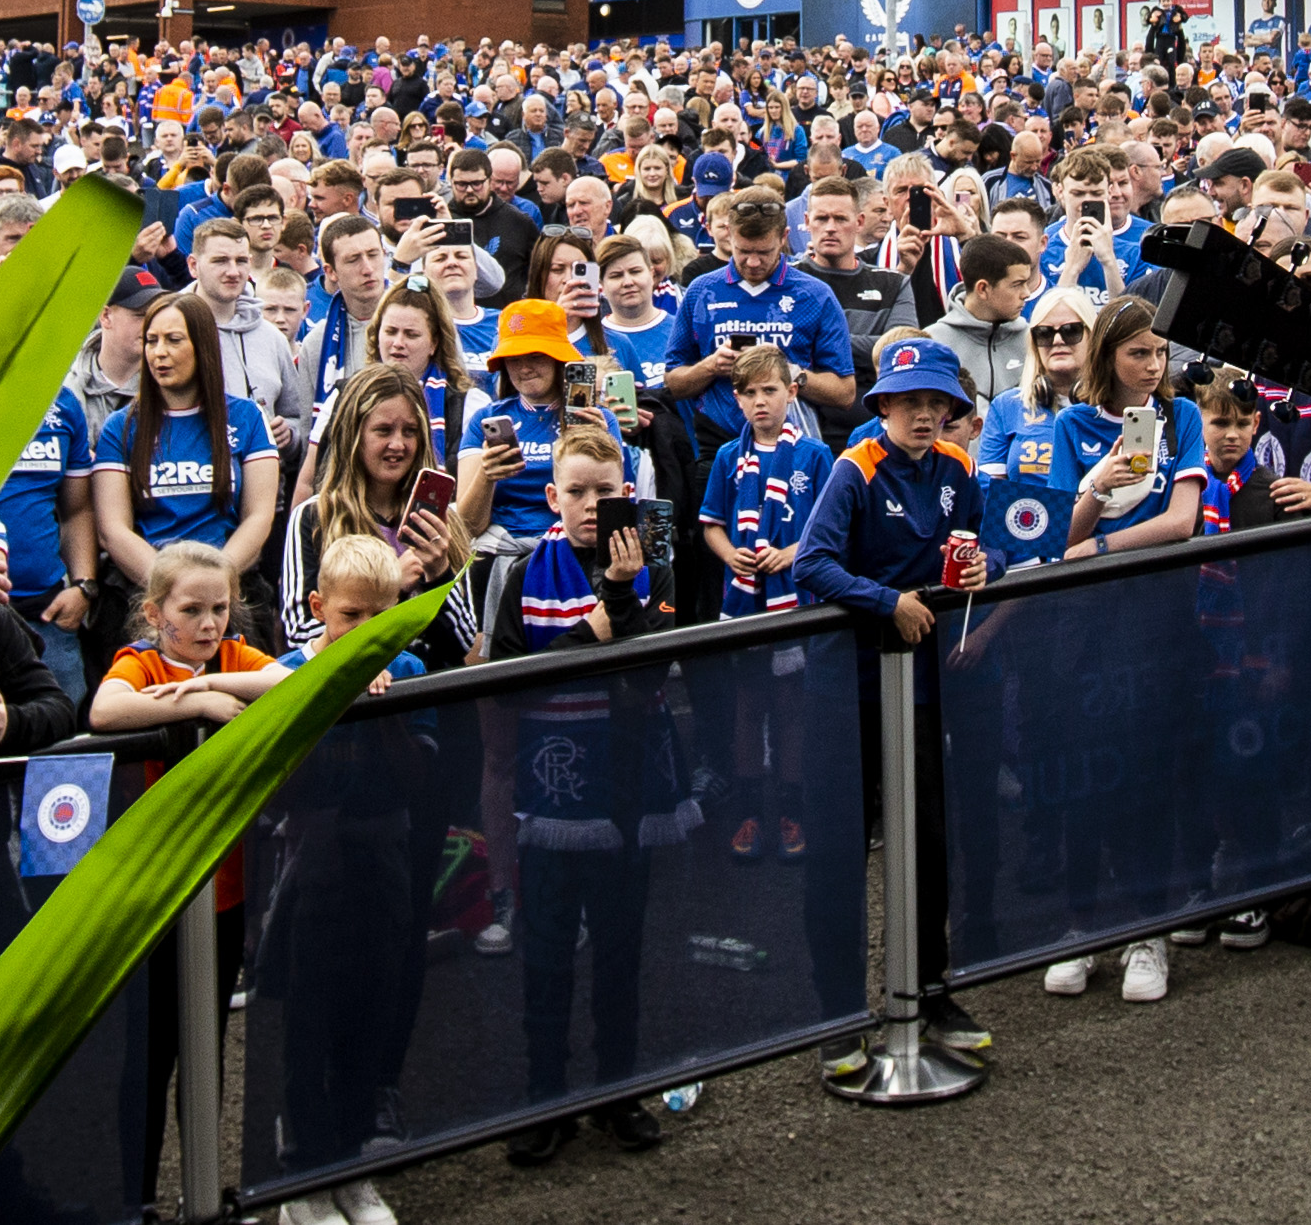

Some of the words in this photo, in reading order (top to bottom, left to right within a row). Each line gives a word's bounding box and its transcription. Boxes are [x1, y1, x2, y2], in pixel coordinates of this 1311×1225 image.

[714, 319, 794, 334] ntl:home
[771, 334, 794, 348] TV
[149, 460, 213, 486] 32Re
